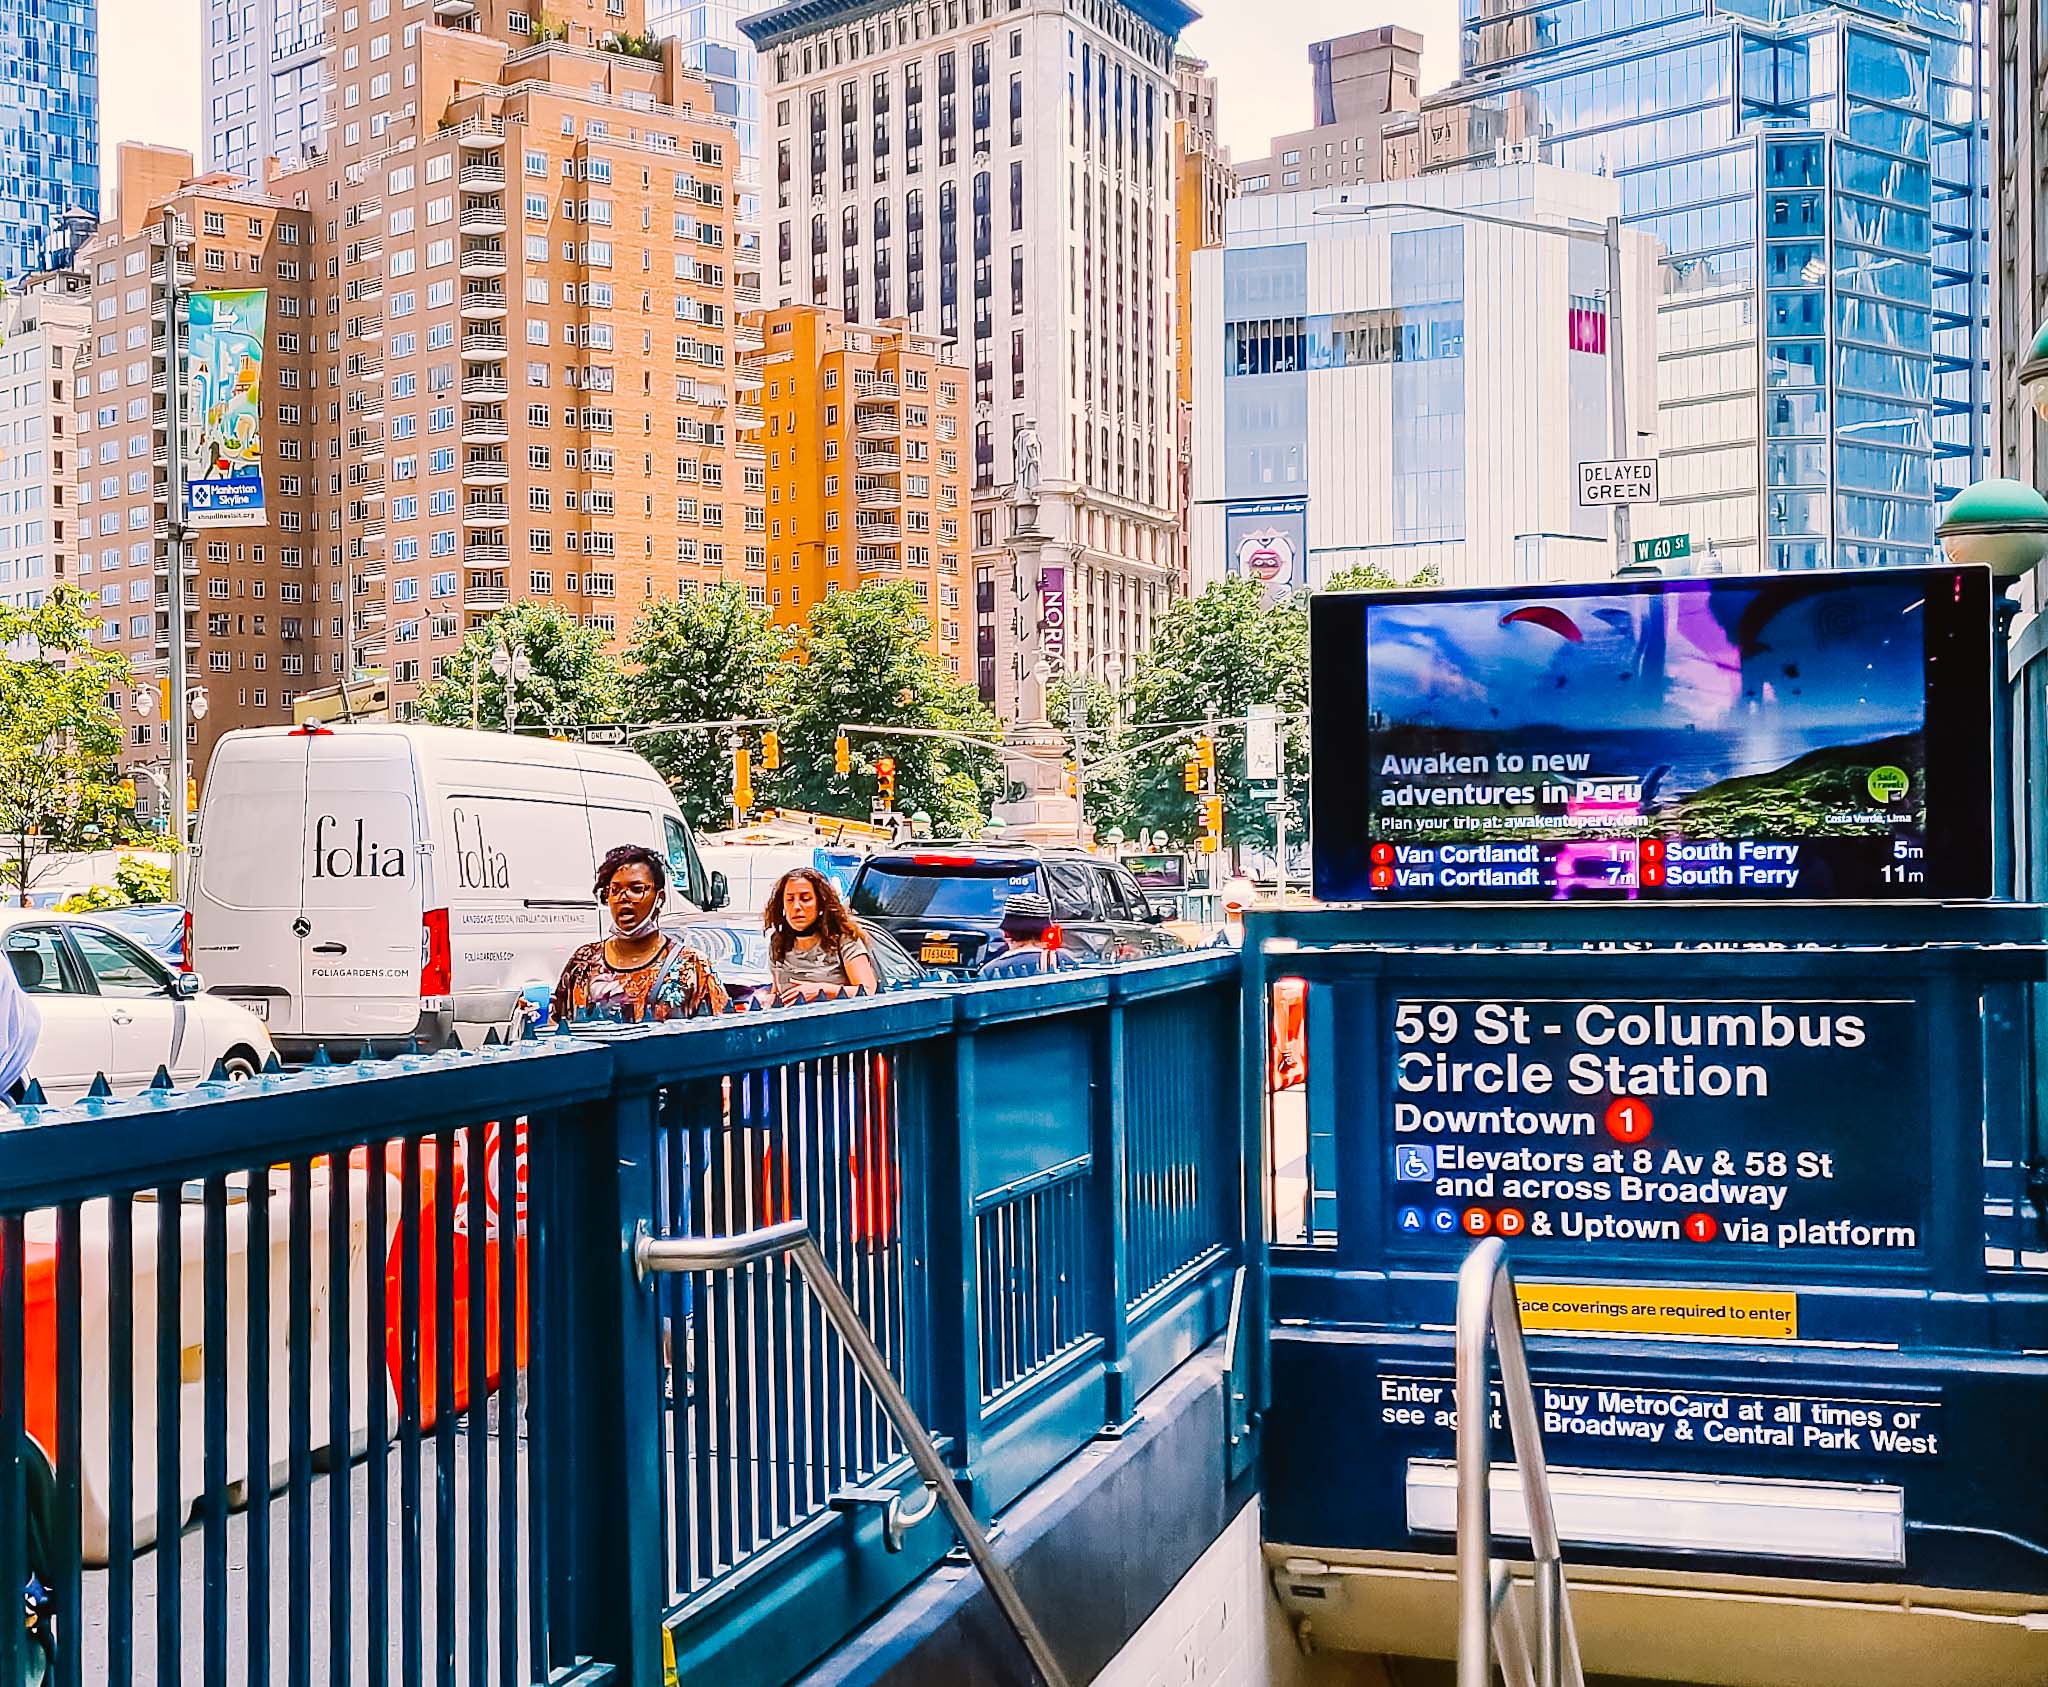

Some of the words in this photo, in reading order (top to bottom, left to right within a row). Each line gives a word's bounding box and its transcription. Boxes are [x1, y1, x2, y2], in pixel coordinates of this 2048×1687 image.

[1585, 465, 1652, 482] DELAYED
[211, 484, 257, 495] Manhattan
[219, 495, 250, 507] Skyline
[1587, 483, 1651, 499] GREEN
[1638, 542, 1649, 560] W
[1654, 540, 1671, 558] 60
[1675, 537, 1684, 549] St
[1381, 753, 1489, 775] Awaken
[1496, 753, 1524, 773] to
[1532, 753, 1590, 772] new
[1381, 784, 1535, 807] adventures
[1542, 781, 1569, 804] in
[1576, 782, 1642, 804] Peru
[1381, 817, 1412, 831] Plan
[1415, 818, 1449, 833] your
[1453, 816, 1479, 831] trip
[1482, 817, 1502, 829] at:
[1825, 814, 1852, 824] Costa
[1886, 814, 1912, 823] Lima
[312, 815, 405, 878] folia
[453, 808, 510, 888] folia
[1395, 846, 1434, 864] Van
[1440, 845, 1540, 864] Cortlandt
[1608, 845, 1636, 862] 1m
[1666, 842, 1732, 861] South
[1739, 842, 1799, 864] Ferry
[1893, 841, 1924, 859] 5m
[1395, 870, 1434, 887] Van
[1440, 867, 1540, 886] Cortlandt
[1607, 867, 1636, 885] 7m
[1666, 866, 1732, 885] South
[1739, 866, 1799, 888] Ferry
[1881, 865, 1924, 883] 11m
[312, 968, 409, 978] FOLIAGARDENS.COM
[1394, 1005, 1458, 1044] 59
[1474, 1004, 1531, 1045] St
[1575, 1004, 1866, 1047] Columbus
[1397, 1052, 1553, 1094] Circle
[1567, 1054, 1768, 1097] Station
[1394, 1104, 1596, 1136] Downtown
[1436, 1145, 1584, 1173] Elevators
[1592, 1150, 1624, 1173] at
[1632, 1149, 1652, 1174] 8
[1660, 1149, 1703, 1175] Av
[1711, 1150, 1736, 1176] &
[1745, 1151, 1787, 1177] 58
[1796, 1152, 1833, 1178] St
[1435, 1173, 1494, 1197] and
[1502, 1178, 1611, 1199] across
[1620, 1176, 1788, 1211] Broadway
[1531, 1211, 1553, 1236] &
[1560, 1212, 1680, 1242] Uptown
[1722, 1217, 1769, 1243] via
[1778, 1219, 1915, 1249] platform
[1552, 1301, 1628, 1317] coverings
[1631, 1304, 1656, 1316] are
[1660, 1304, 1726, 1319] required
[1729, 1307, 1746, 1319] to
[1749, 1308, 1791, 1322] enter
[1381, 1381, 1443, 1403] Enter
[1544, 1388, 1589, 1414] buy
[1598, 1391, 1728, 1419] MetroCard
[1738, 1401, 1763, 1422] at
[1773, 1402, 1800, 1424] all
[1811, 1403, 1882, 1428] times
[1893, 1412, 1921, 1430] or
[1382, 1407, 1426, 1426] see
[1434, 1409, 1502, 1430] agt
[1544, 1411, 1665, 1442] Broadway
[1674, 1418, 1694, 1441] &
[1703, 1420, 1793, 1446] Central
[1803, 1426, 1860, 1450] Park
[1869, 1429, 1937, 1454] West
